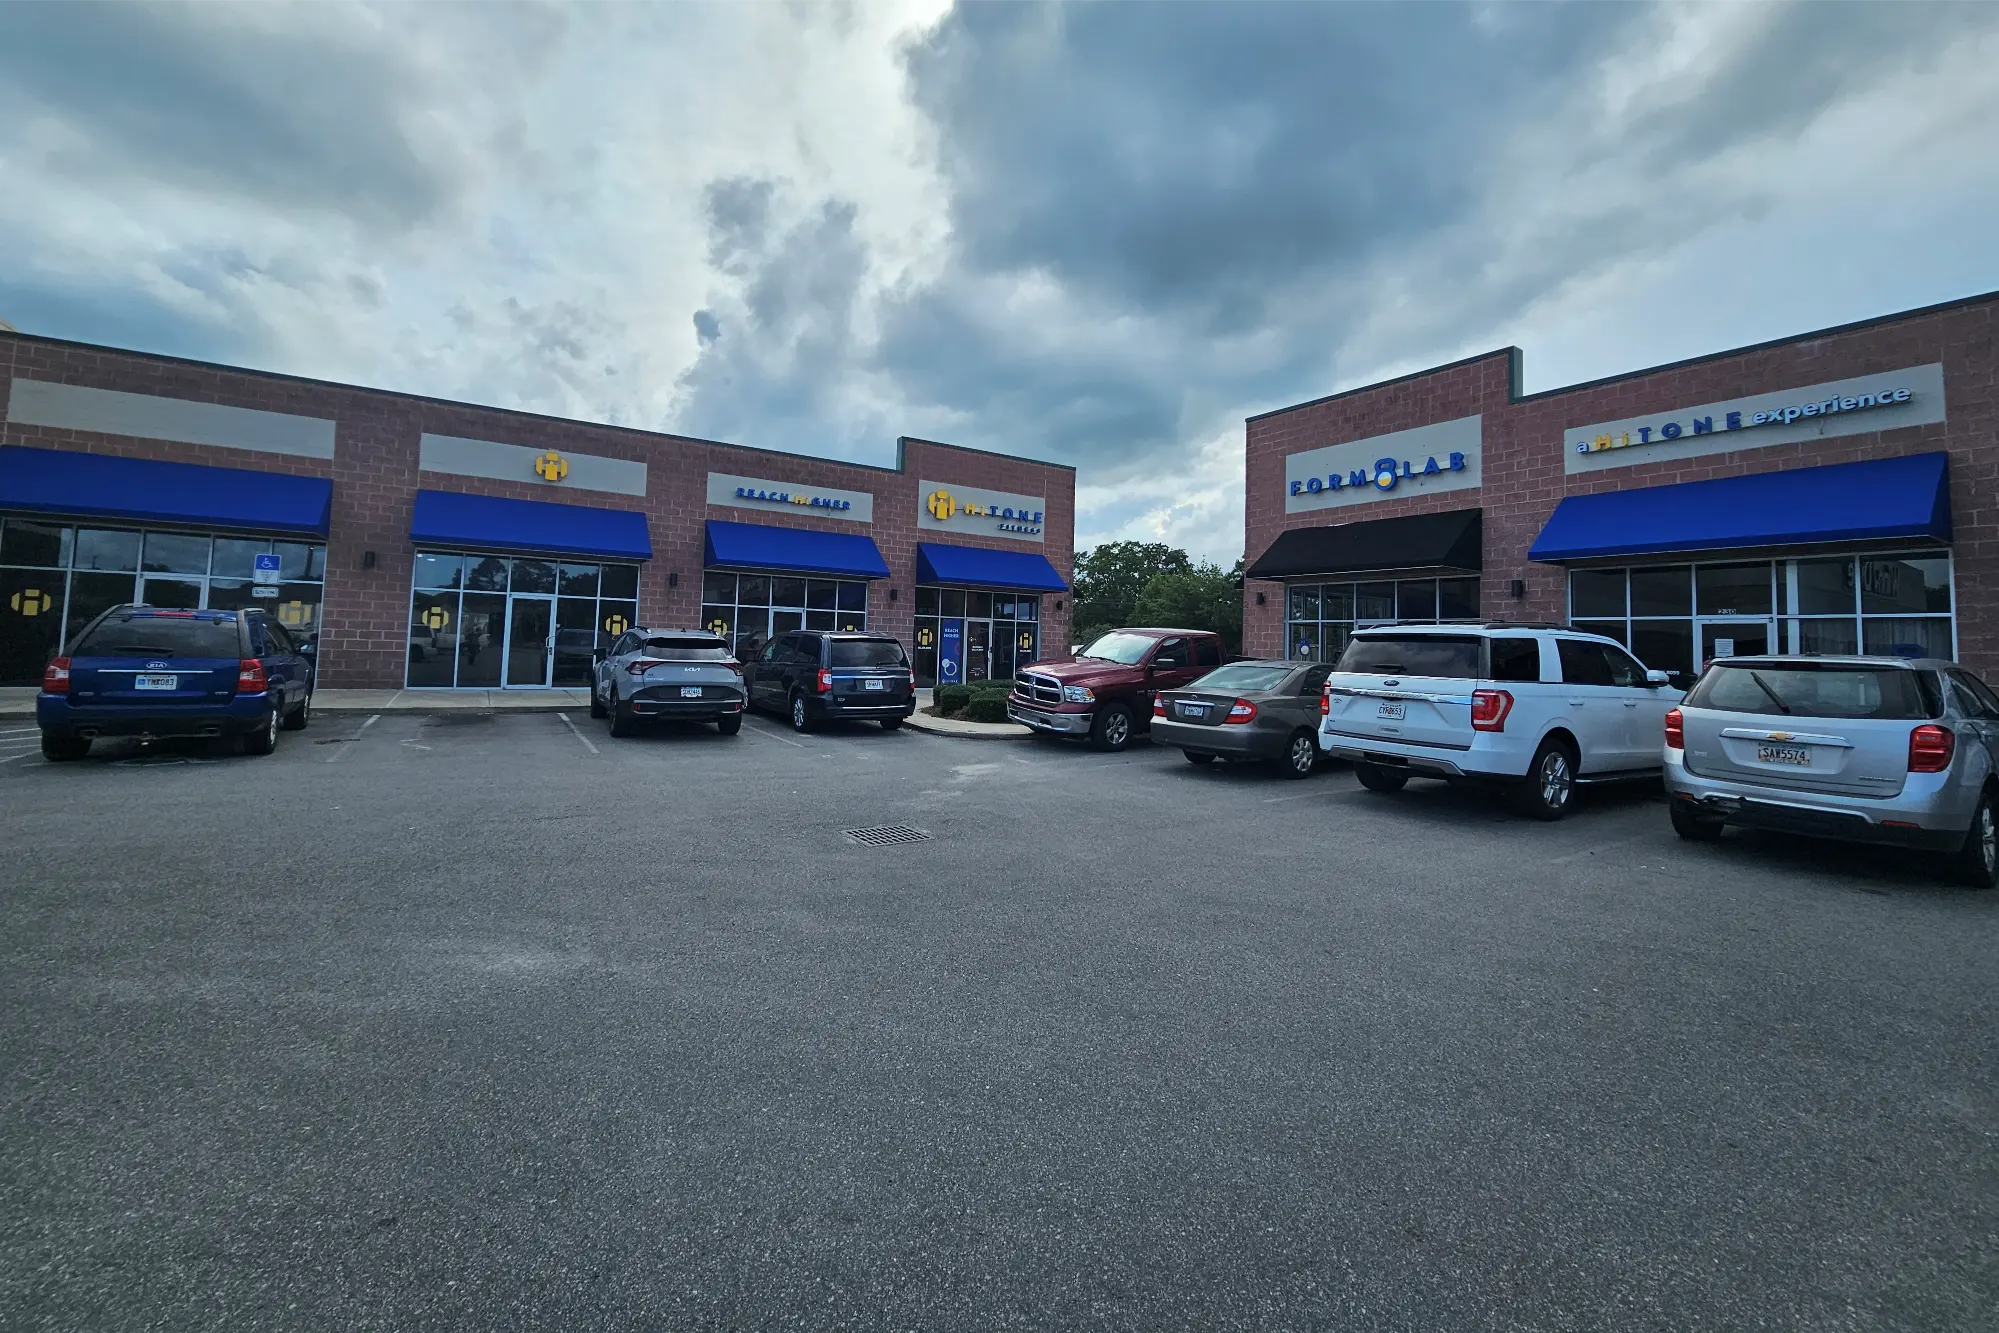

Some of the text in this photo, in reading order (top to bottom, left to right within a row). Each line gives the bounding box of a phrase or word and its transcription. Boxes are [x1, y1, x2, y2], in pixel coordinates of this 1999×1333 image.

[1576, 441, 1590, 453] a
[1752, 387, 1913, 425] experience
[735, 487, 789, 503] REACH
[997, 523, 1041, 535] FITNESS
[1763, 747, 1806, 761] SAW5574
